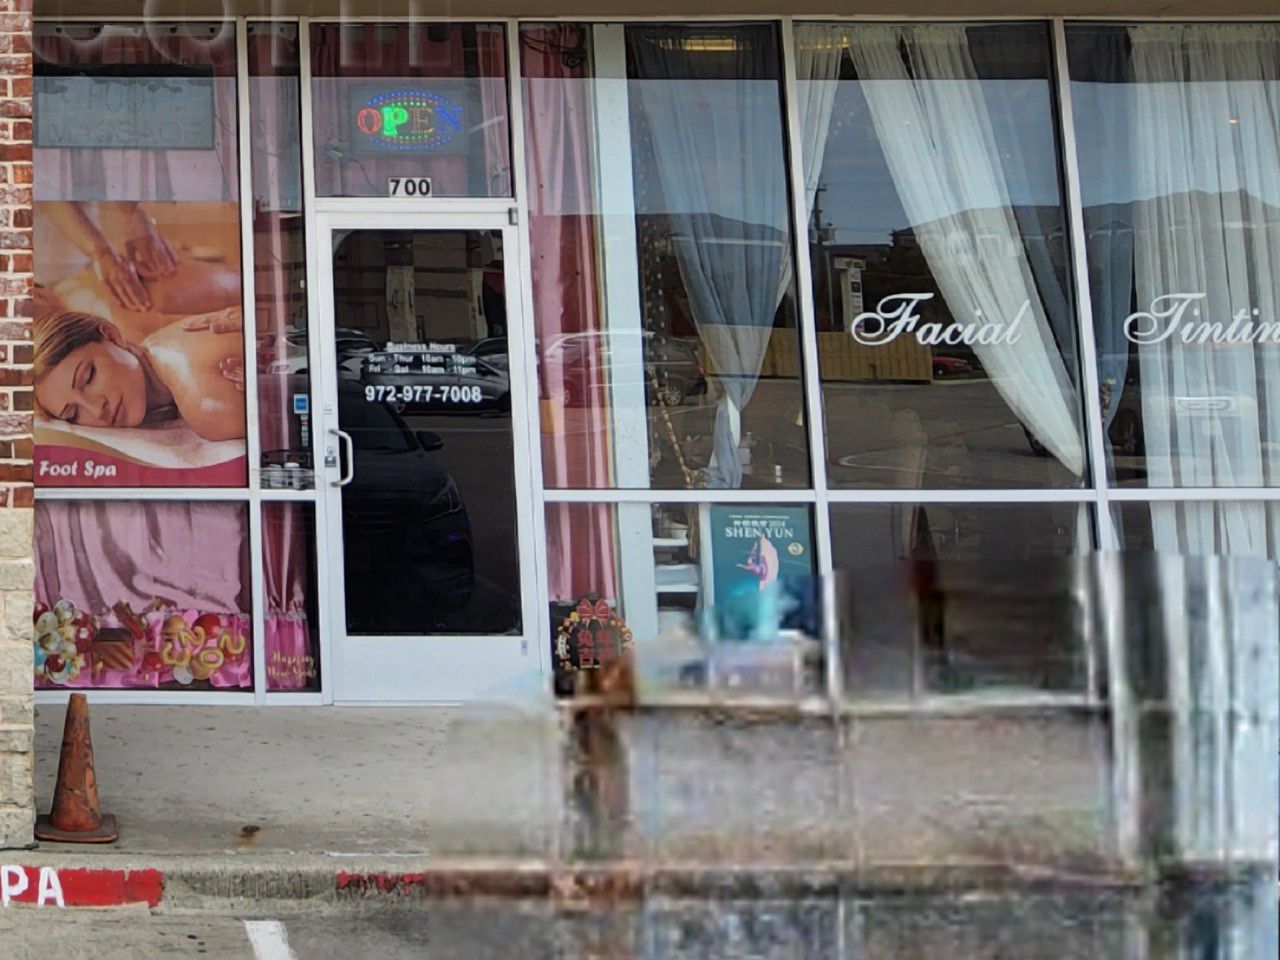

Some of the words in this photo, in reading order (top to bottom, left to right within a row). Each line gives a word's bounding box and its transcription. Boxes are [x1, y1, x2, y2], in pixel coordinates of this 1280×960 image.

[356, 105, 463, 136] OPEN
[389, 178, 431, 196] 700
[850, 292, 1031, 346] Facial
[365, 385, 482, 402] 972-977-7008
[40, 460, 78, 476] Foot
[84, 460, 117, 479] Spa
[725, 527, 761, 538] SHEN
[765, 527, 793, 538] YUN
